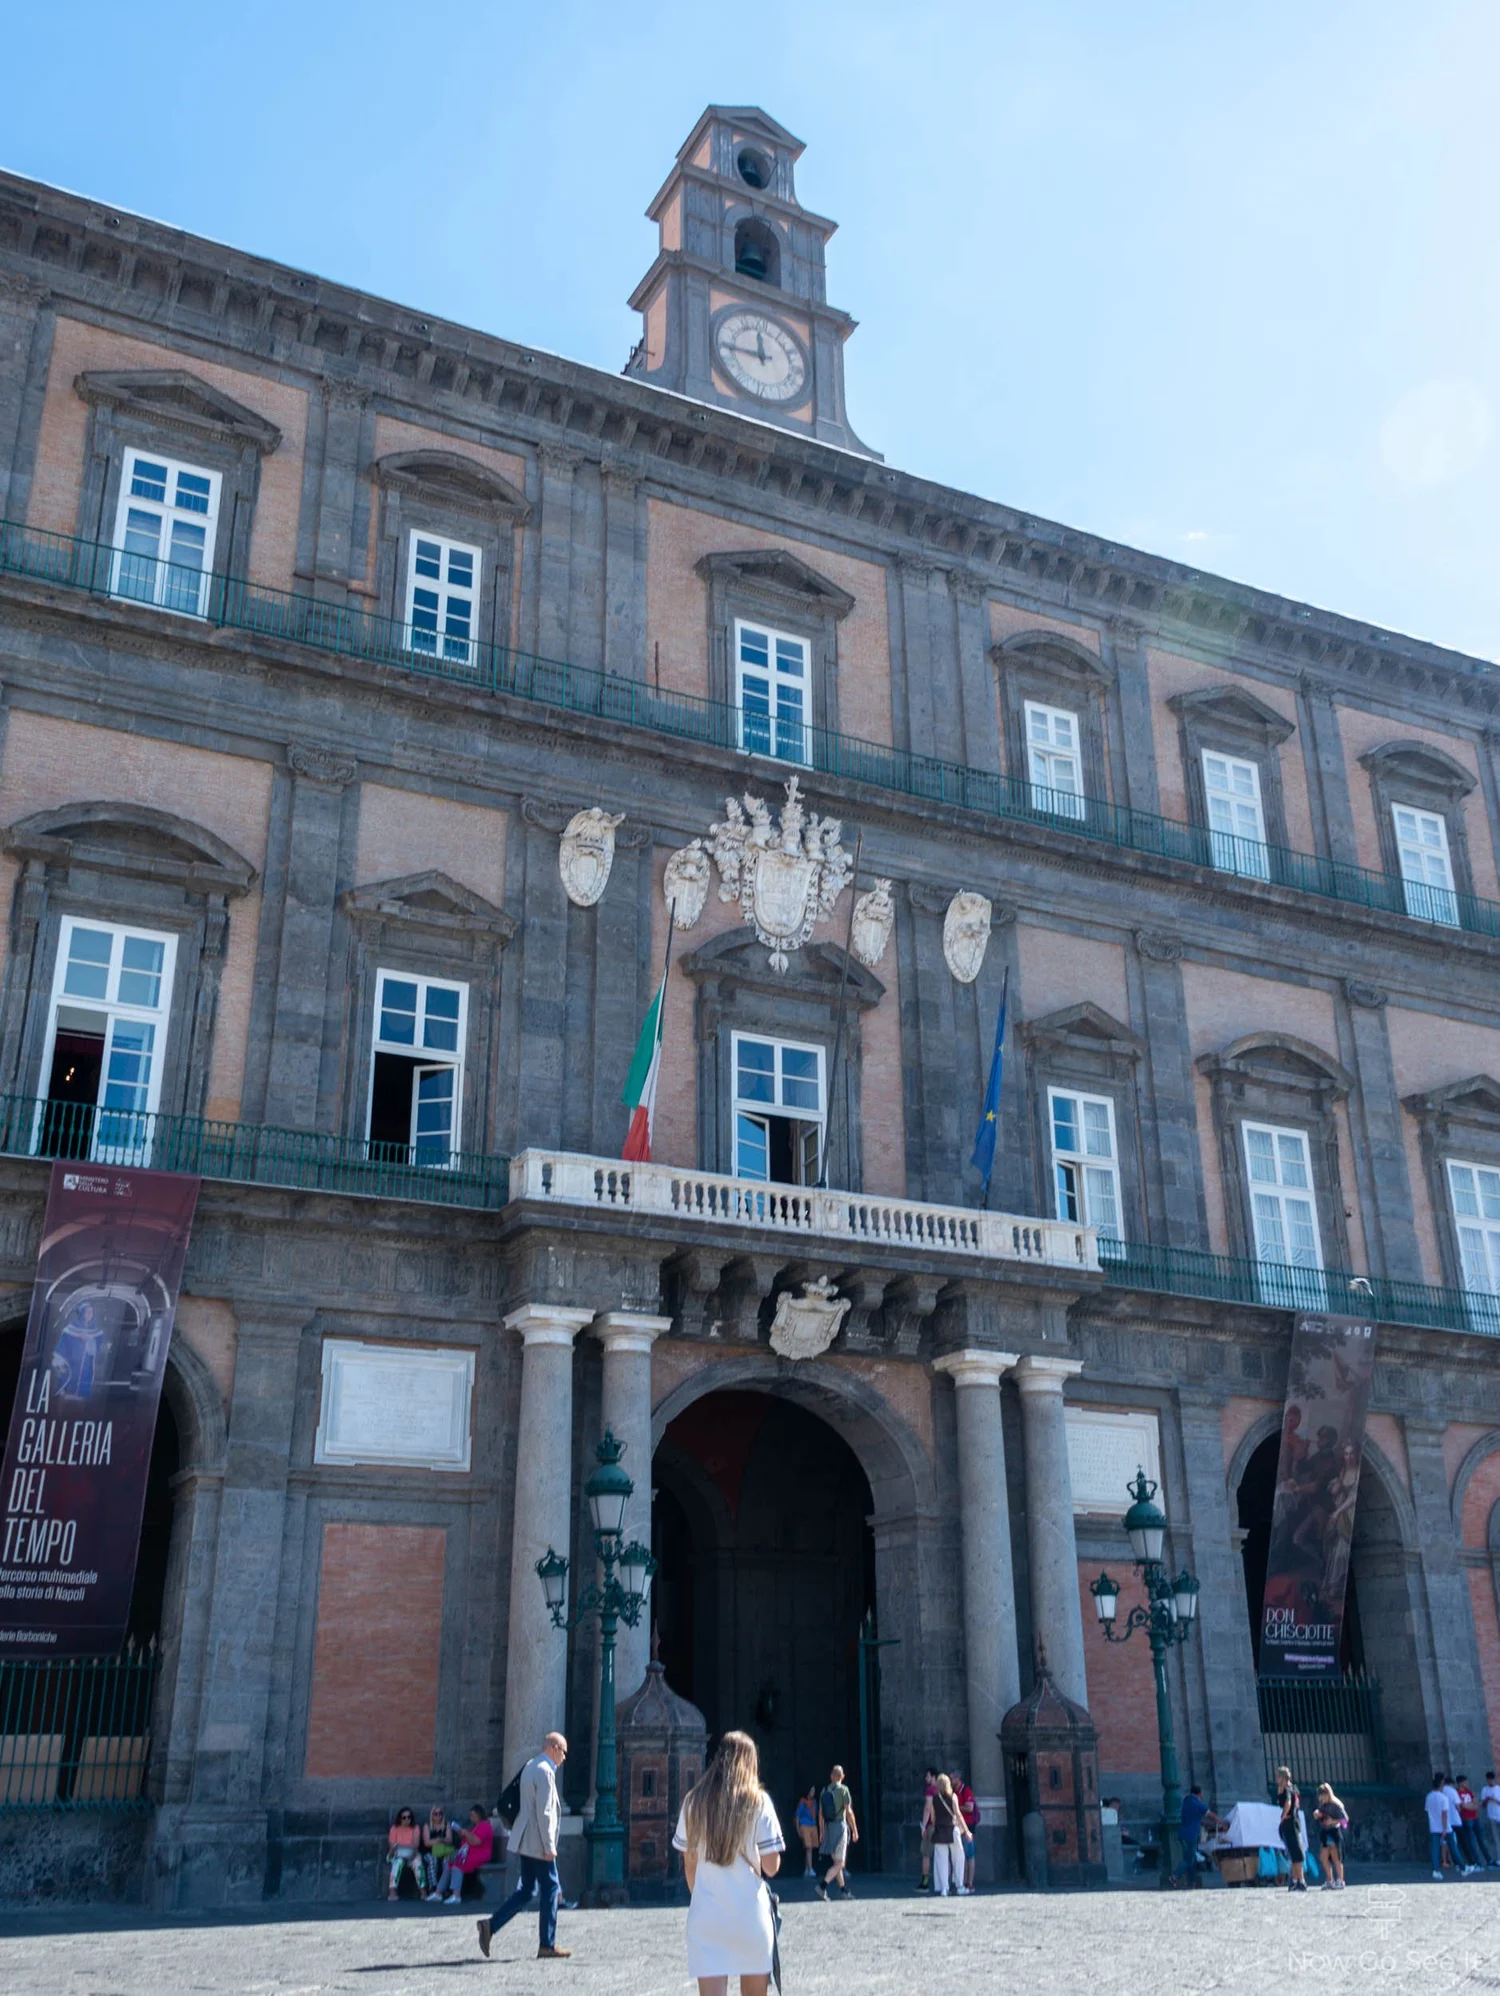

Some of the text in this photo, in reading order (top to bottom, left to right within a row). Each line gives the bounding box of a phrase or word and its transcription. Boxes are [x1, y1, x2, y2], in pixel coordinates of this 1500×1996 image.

[78, 1185, 107, 1194] CULTURA
[25, 1368, 51, 1414] LA
[17, 1418, 113, 1465] GALLERIA
[7, 1468, 46, 1514] DEL
[2, 1518, 77, 1565] TEMPO
[38, 1569, 98, 1584] multimediale
[16, 1585, 43, 1599] storia
[44, 1586, 54, 1599] di
[55, 1586, 86, 1602] Napoli
[1266, 1607, 1295, 1624] DON
[1265, 1623, 1335, 1640] CHISCIOTTE
